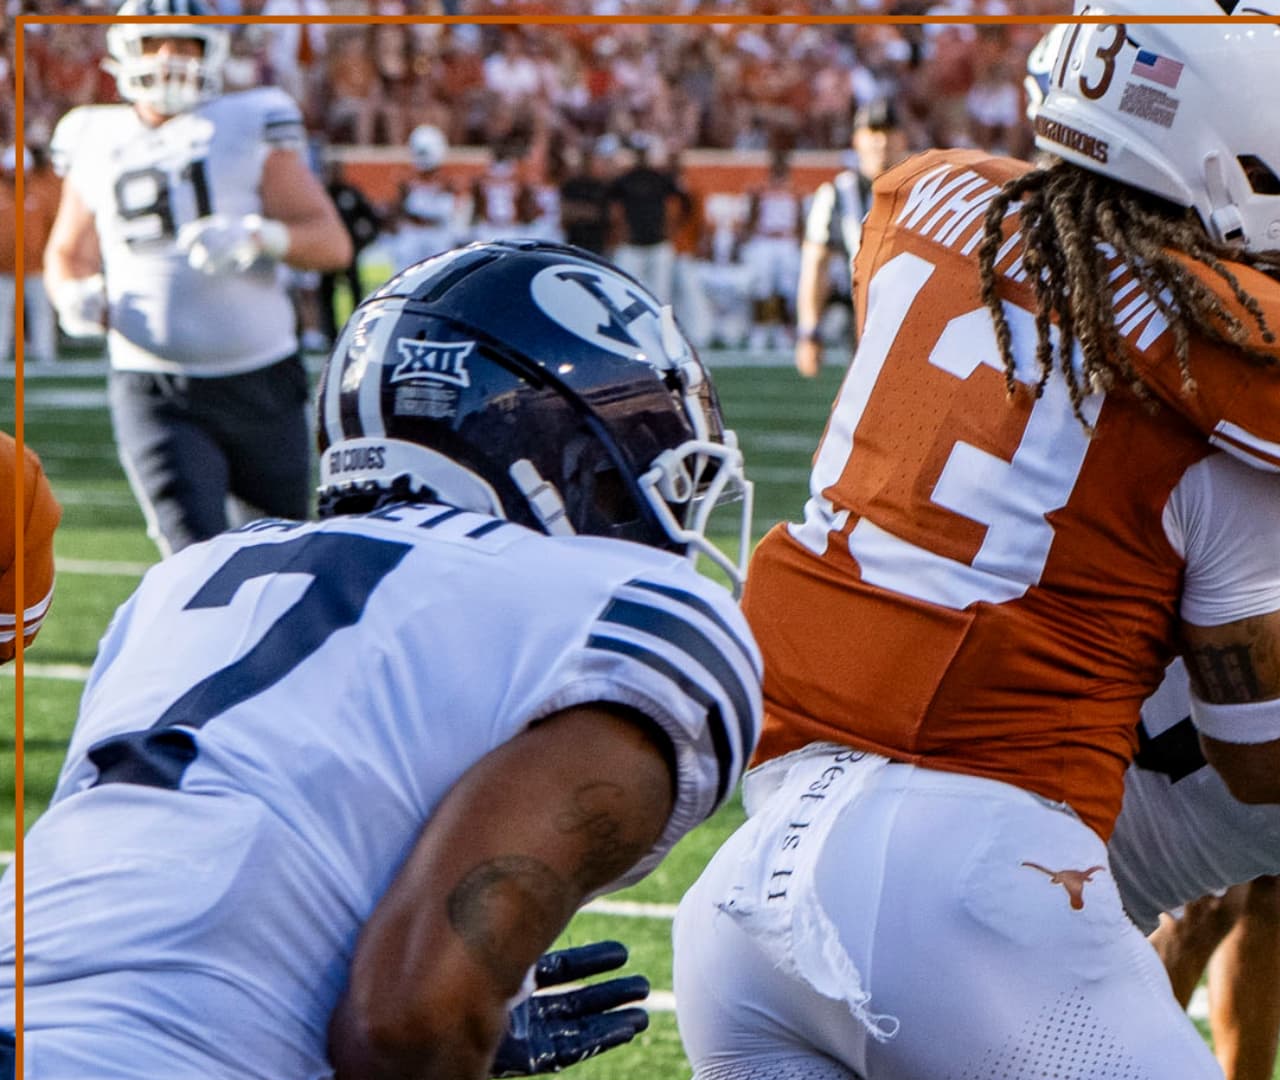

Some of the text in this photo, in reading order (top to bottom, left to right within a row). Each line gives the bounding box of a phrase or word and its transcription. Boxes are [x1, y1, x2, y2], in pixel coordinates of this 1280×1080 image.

[114, 160, 213, 254] 91
[788, 251, 1104, 610] 13
[88, 530, 414, 791] 7
